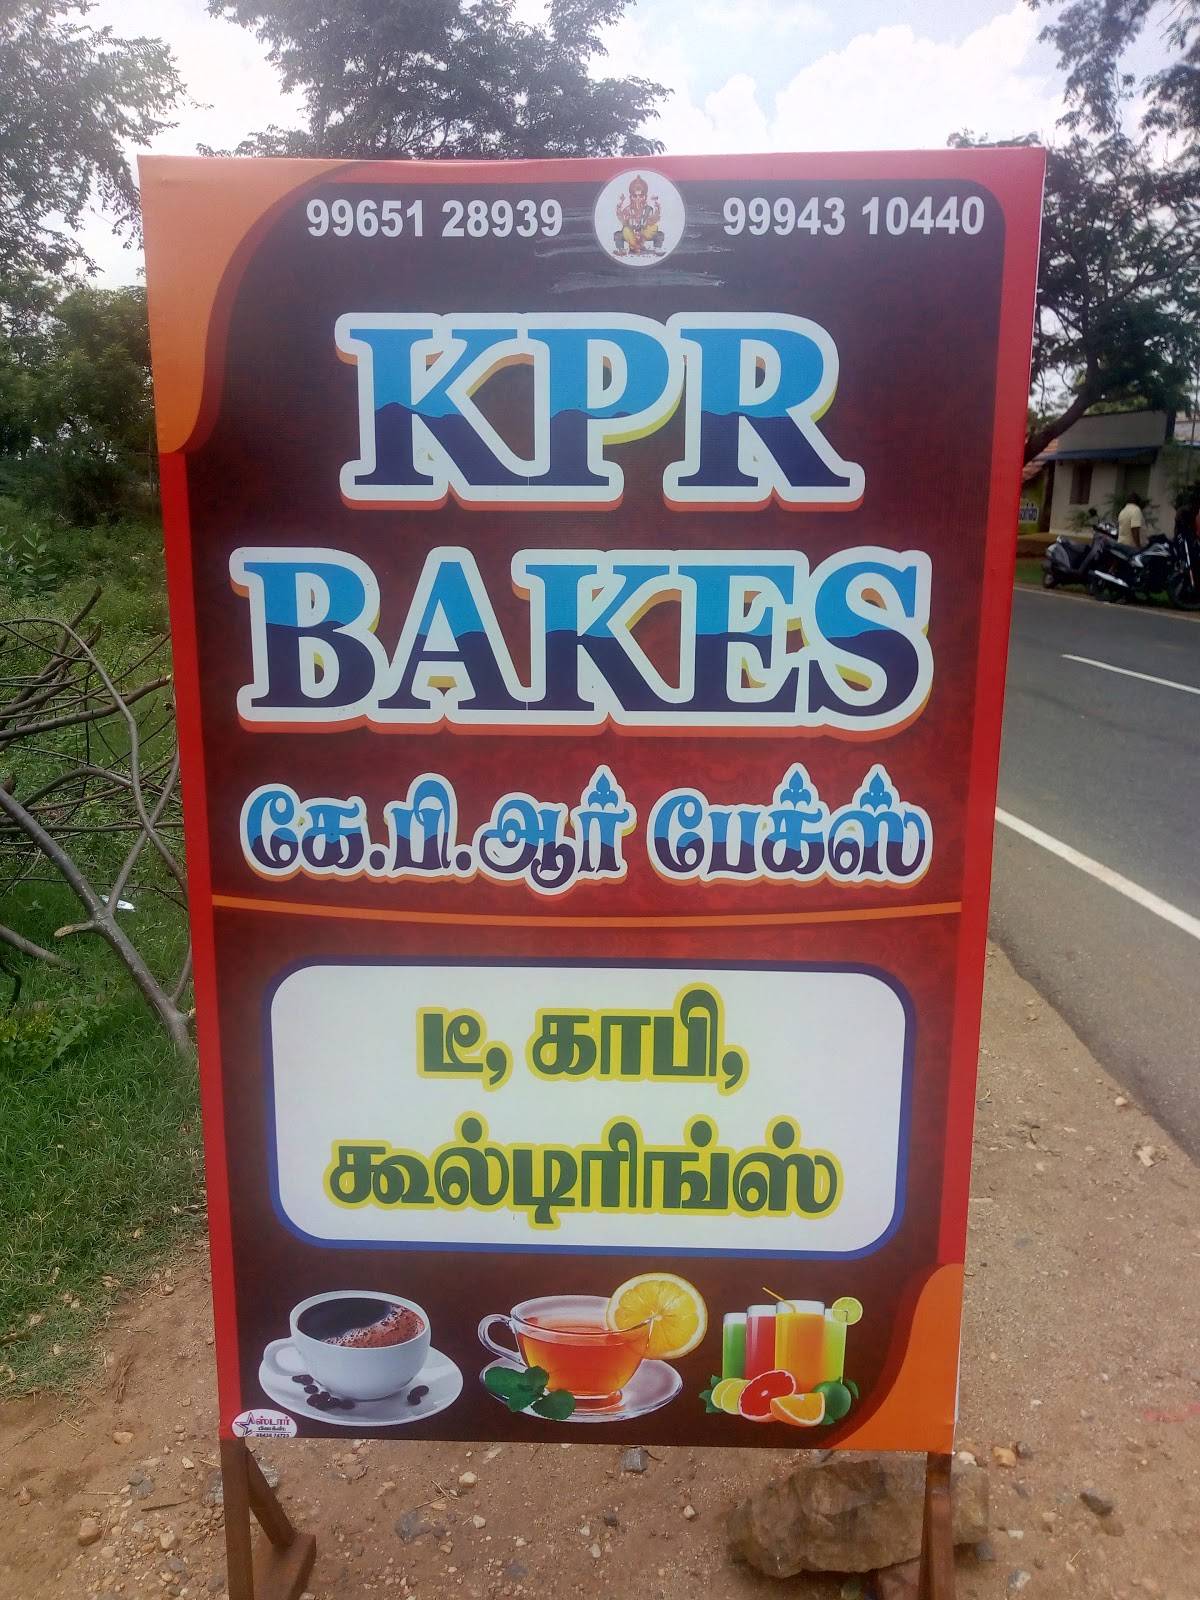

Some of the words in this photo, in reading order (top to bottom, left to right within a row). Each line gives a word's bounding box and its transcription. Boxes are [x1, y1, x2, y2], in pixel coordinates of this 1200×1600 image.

[306, 198, 423, 237] 99651
[441, 198, 563, 237] 28939
[723, 197, 846, 236] 99943
[862, 195, 985, 236] 10440
[336, 313, 865, 503] KPR
[230, 547, 933, 730] BAKES
[241, 765, 637, 894] கே.பி.ஆர்
[647, 763, 933, 882] பேக்ஸ்
[416, 1007, 512, 1091] டீ,
[525, 983, 747, 1095] காபி,
[324, 1111, 843, 1230] கூல்டிரிங்ஸ்
